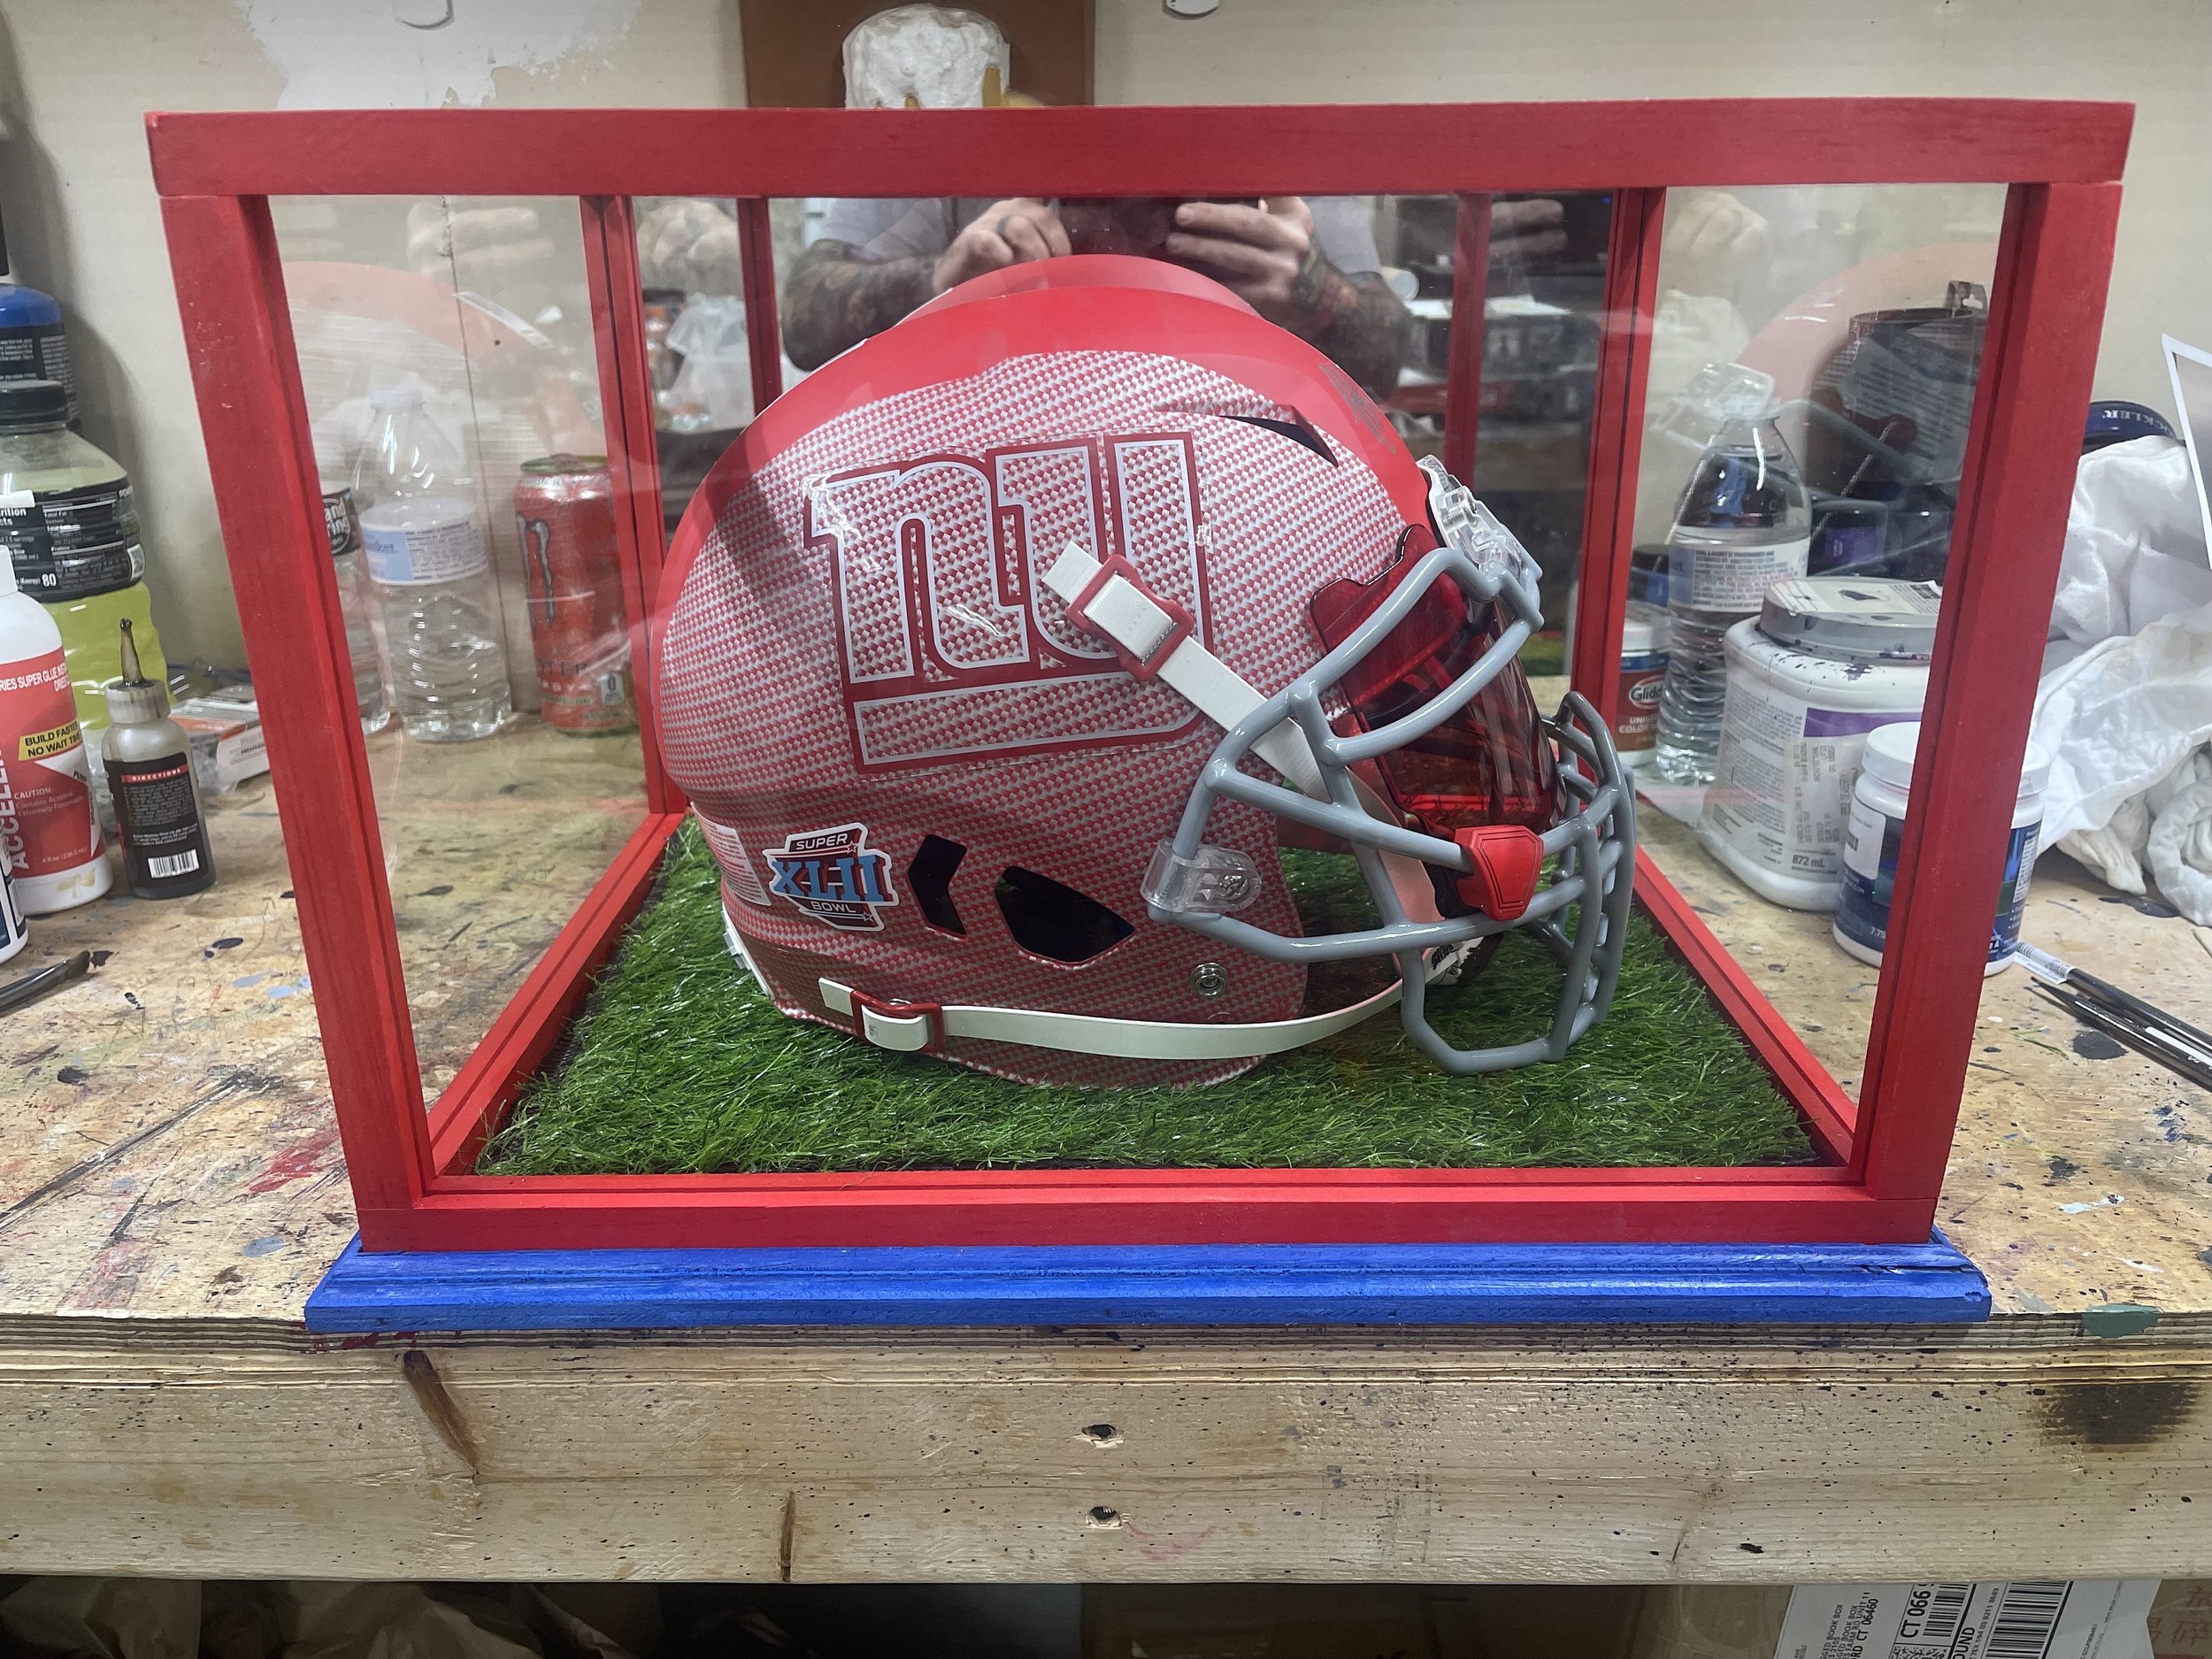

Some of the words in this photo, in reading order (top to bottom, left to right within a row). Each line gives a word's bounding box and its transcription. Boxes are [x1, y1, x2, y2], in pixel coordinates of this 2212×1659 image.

[42, 572, 57, 588] 80
[0, 678, 18, 691] RIES
[18, 672, 45, 689] SUPER
[42, 666, 58, 683] GLUE
[1630, 684, 1663, 701] Glidd
[25, 732, 55, 747] BUILD
[27, 746, 44, 757] NO
[45, 739, 68, 754] WAIT
[132, 767, 180, 781] DIRECTIONS
[795, 832, 849, 851] SUPER
[1792, 854, 1810, 867] 872
[1810, 856, 1825, 869] mL
[772, 854, 885, 902] XLII
[810, 900, 856, 914] BOWL
[1861, 1598, 1879, 1625] 06460
[1907, 1590, 1932, 1617] 066
[1847, 1605, 1858, 1620] BOX
[1826, 1620, 1839, 1640] BOOK
[1833, 1604, 1844, 1618] BOX
[1846, 1632, 1857, 1652] FARM
[1856, 1601, 1867, 1619] UNIT
[1900, 1619, 1922, 1639] CT
[1841, 1621, 1854, 1641] BOOK
[1856, 1629, 1870, 1641] CT
[1831, 1636, 1840, 1653] 2105
[1850, 1645, 1863, 1659] RD
